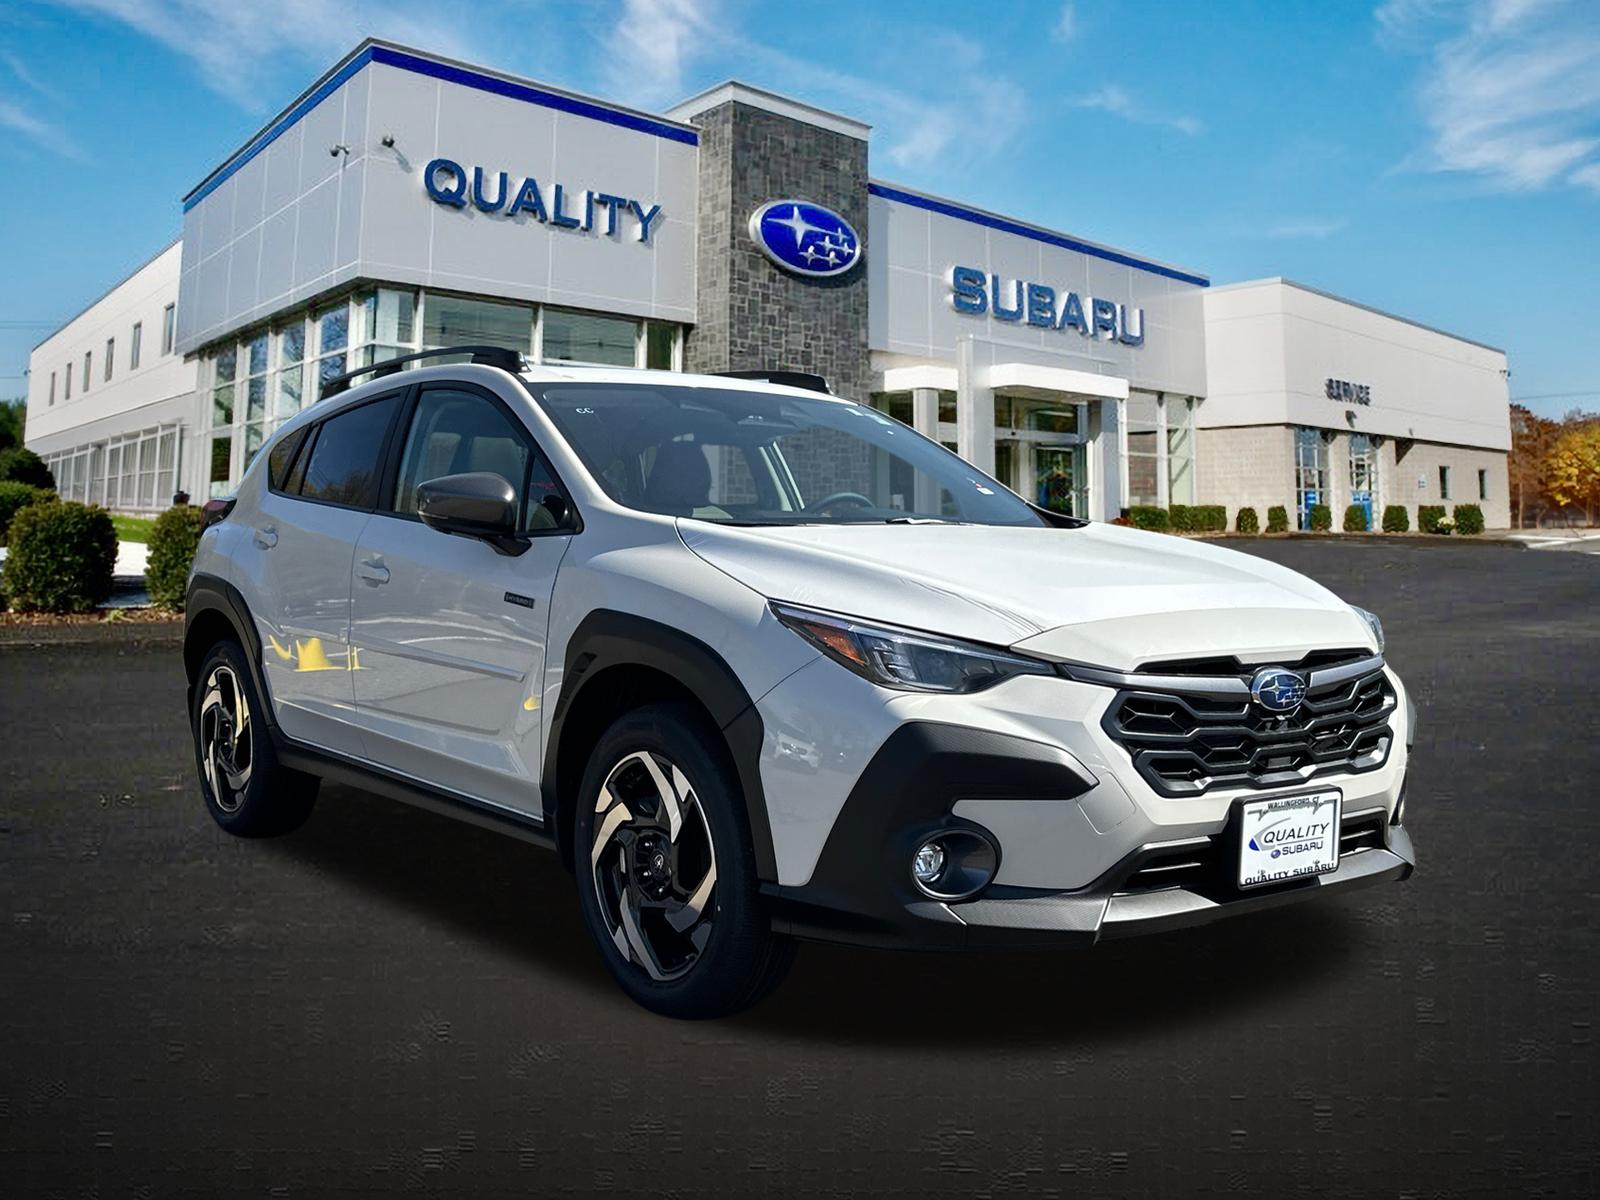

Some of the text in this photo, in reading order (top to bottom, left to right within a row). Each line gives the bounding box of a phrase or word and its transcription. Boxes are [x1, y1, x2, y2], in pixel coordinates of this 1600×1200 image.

[424, 158, 661, 243] QUALITY
[950, 266, 1144, 346] SUBARU
[1263, 822, 1330, 843] QUALITY
[1282, 841, 1324, 856] SUBARU
[1244, 863, 1335, 885] QUALITY SUBARU
